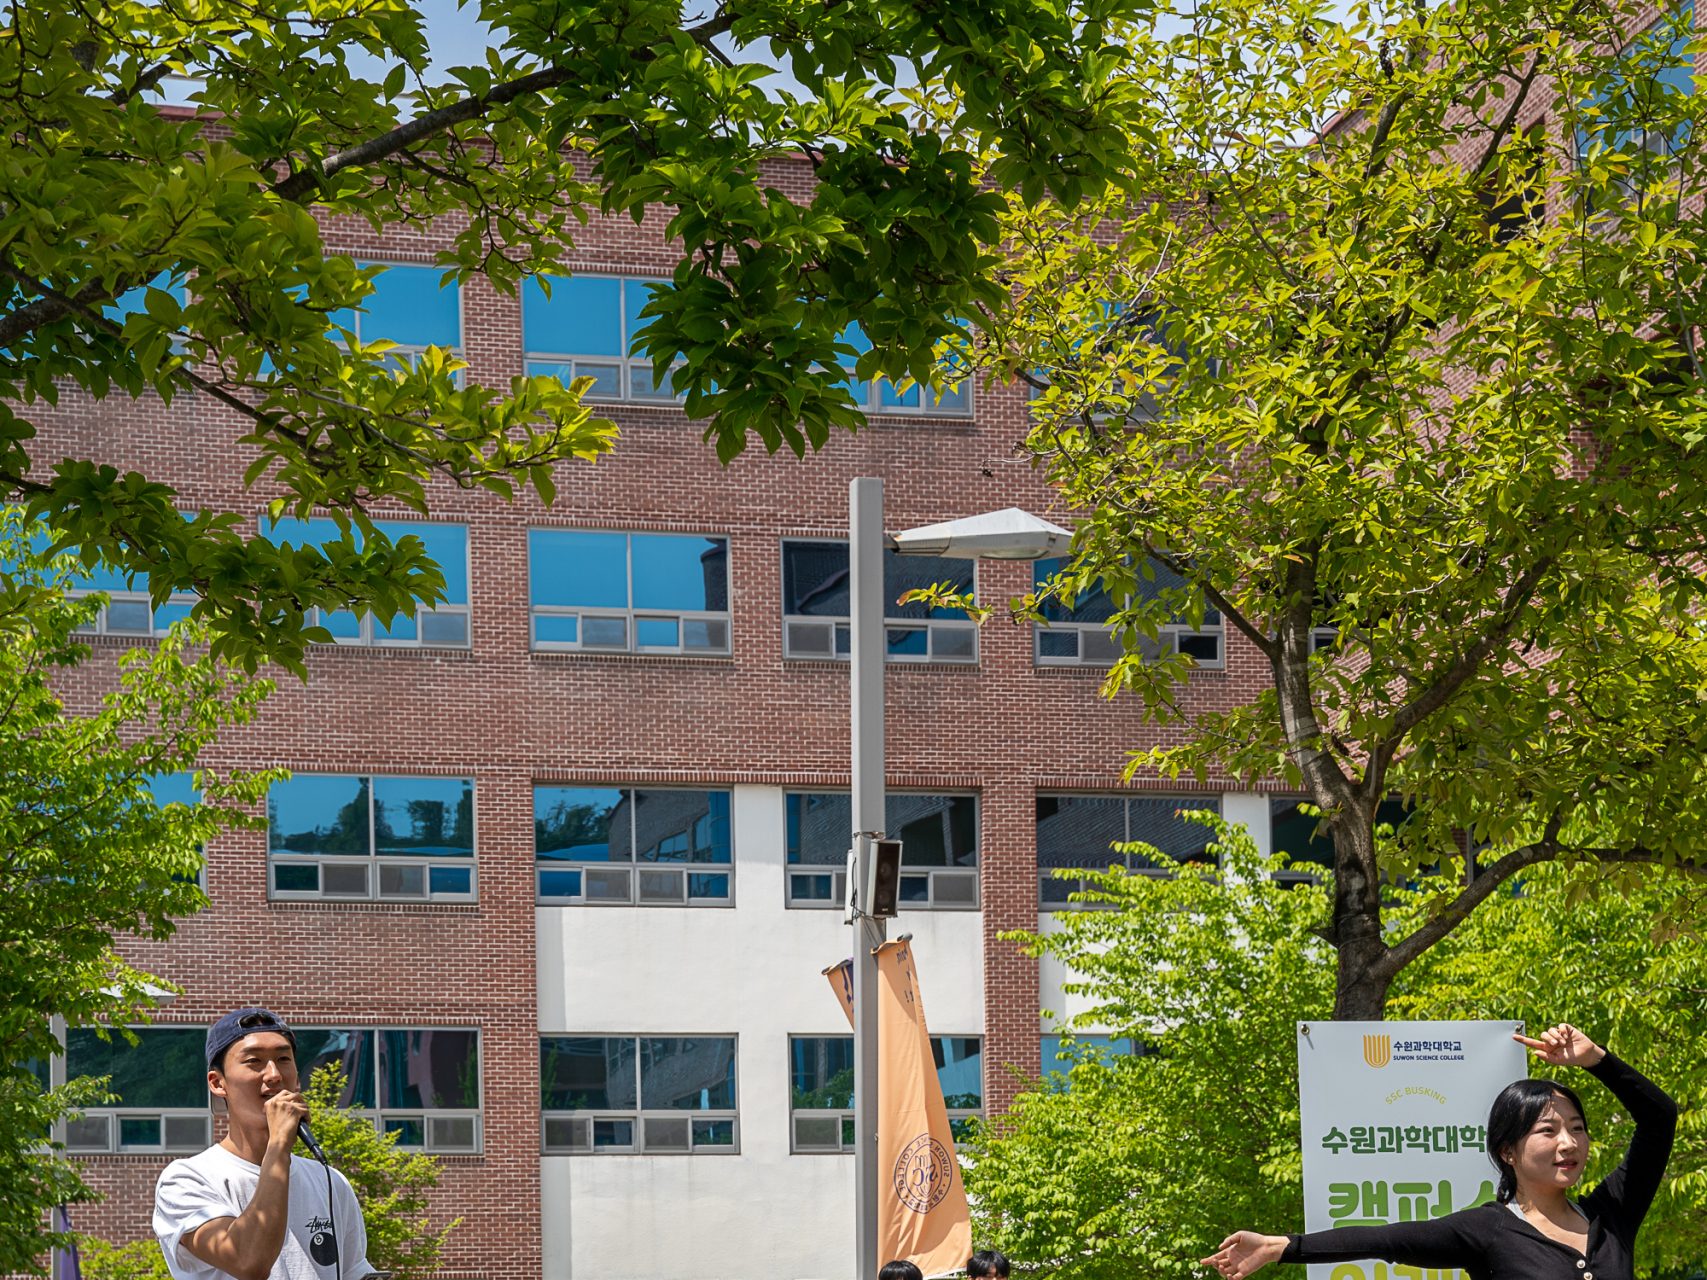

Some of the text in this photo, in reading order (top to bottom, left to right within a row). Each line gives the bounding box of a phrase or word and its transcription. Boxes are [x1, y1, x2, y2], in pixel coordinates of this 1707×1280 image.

[1393, 1041, 1462, 1052] 수원과학대학교
[1385, 1086, 1447, 1105] SSC BUSKING
[1322, 1125, 1487, 1155] 수원과학대학
